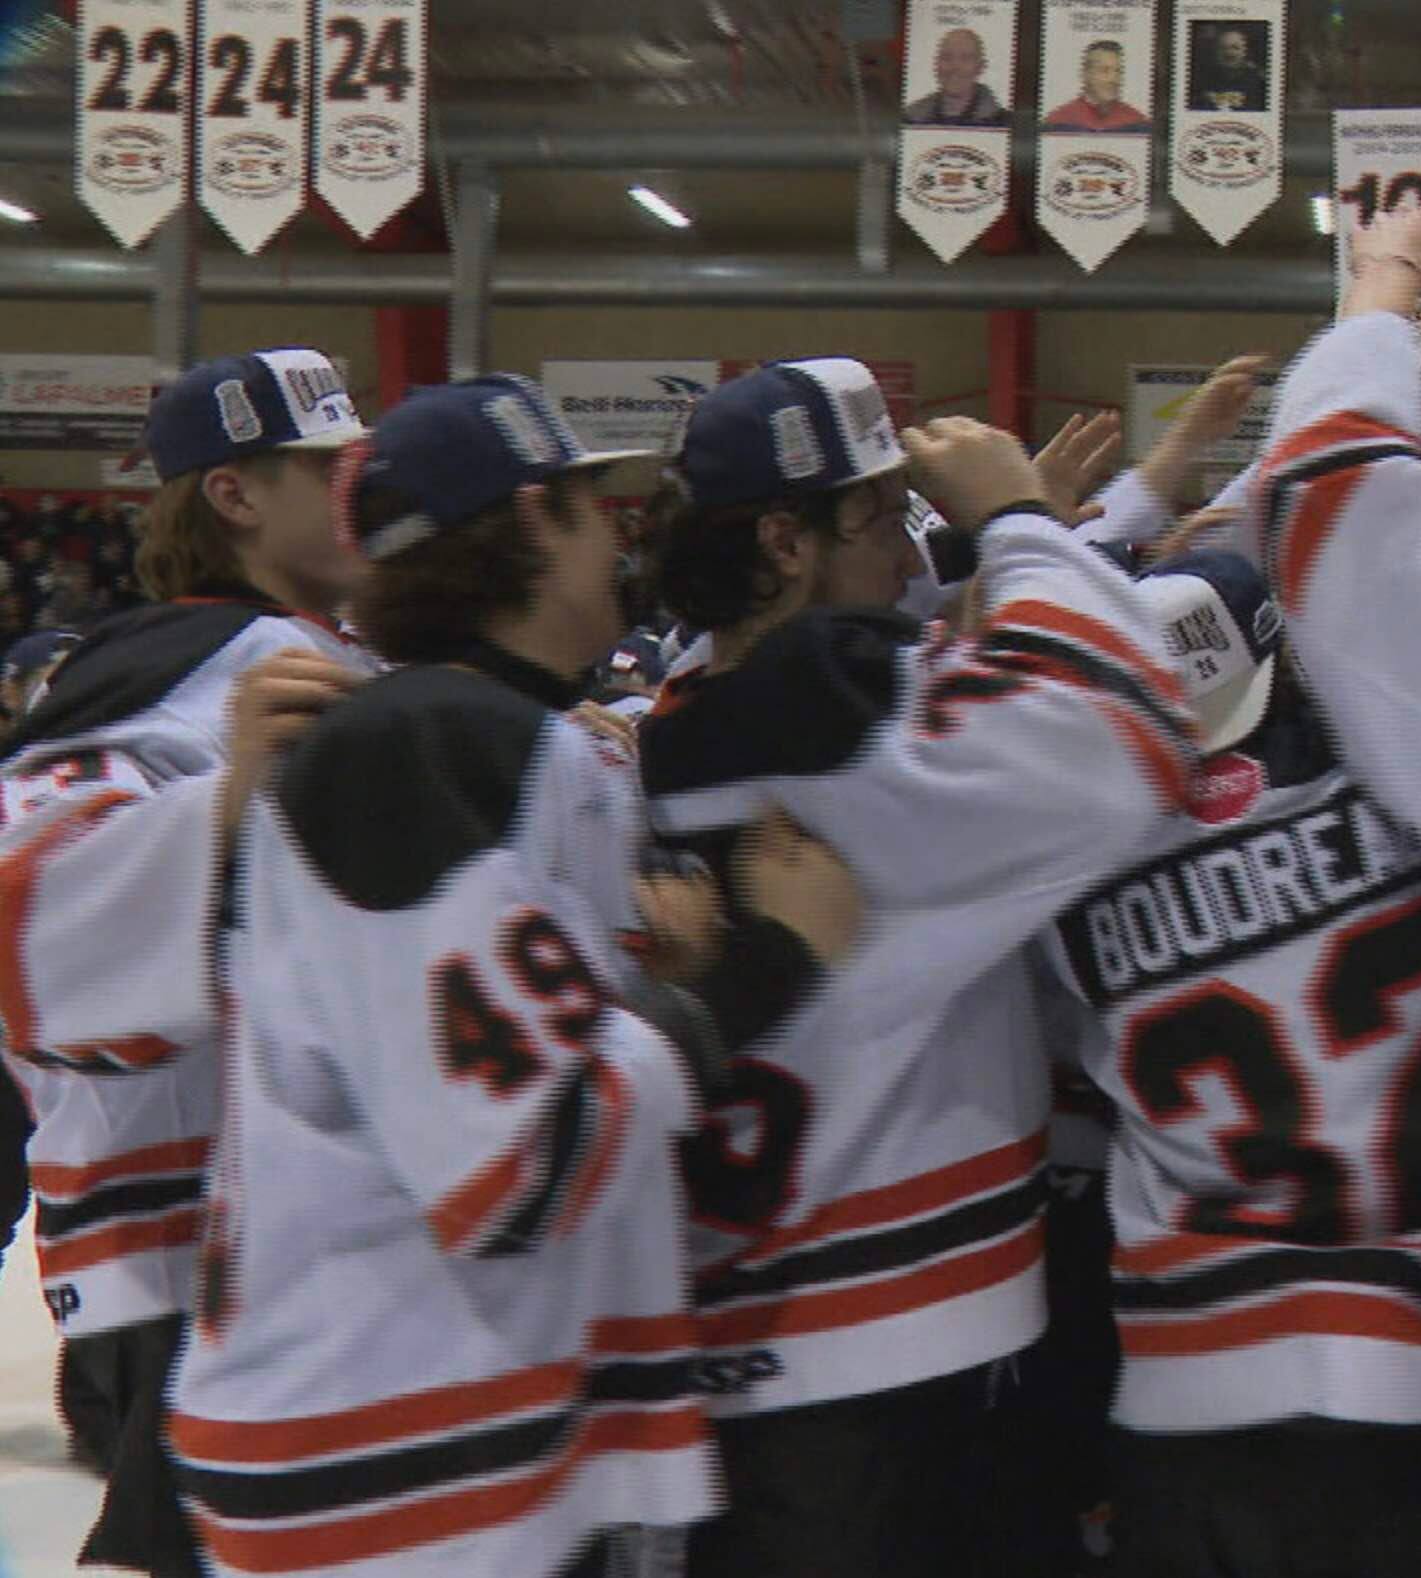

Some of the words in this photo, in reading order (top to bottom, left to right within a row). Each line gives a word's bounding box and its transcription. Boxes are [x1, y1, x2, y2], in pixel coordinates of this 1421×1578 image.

[86, 25, 184, 113] 22
[206, 34, 303, 120] 24
[324, 16, 415, 102] 24
[427, 904, 622, 1099] 49
